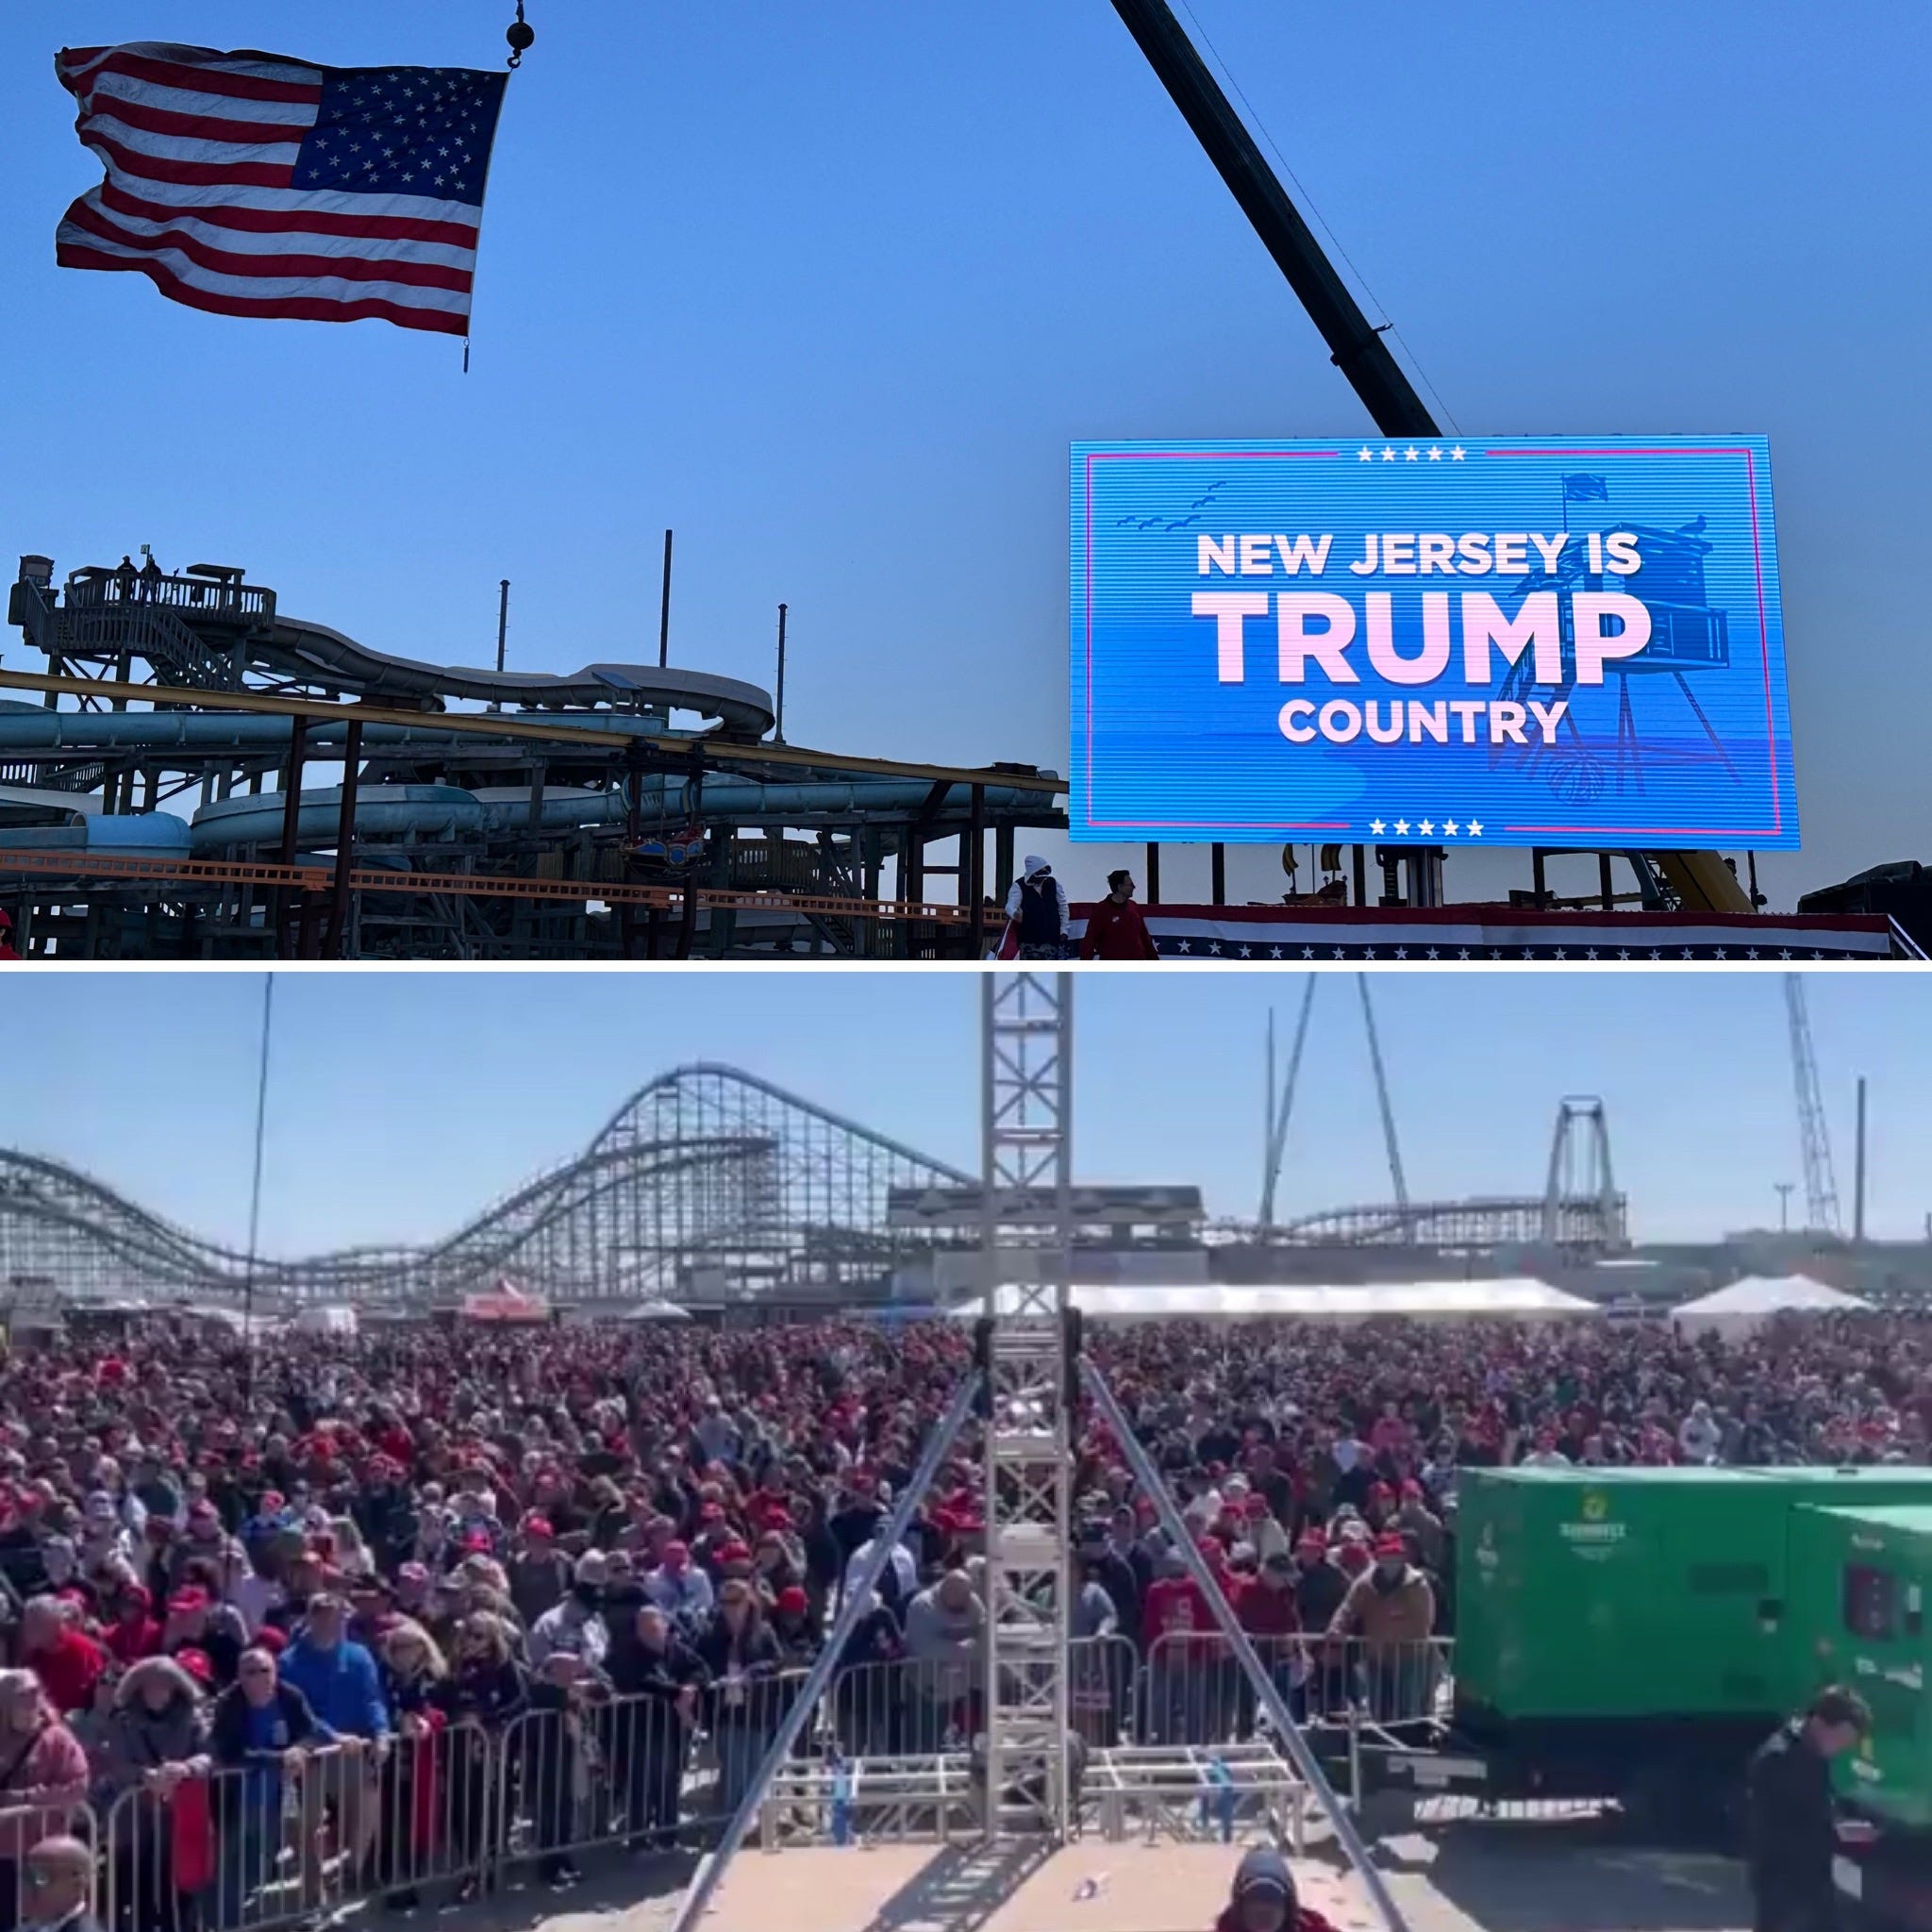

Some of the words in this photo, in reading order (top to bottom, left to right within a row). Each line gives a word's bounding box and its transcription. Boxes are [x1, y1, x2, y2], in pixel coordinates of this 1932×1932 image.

[1198, 534, 1333, 575] NEW
[1350, 533, 1569, 575] JERSEY
[1588, 532, 1641, 575] IS
[1191, 591, 1652, 685] TRUMP
[1278, 699, 1569, 743] COUNTRY
